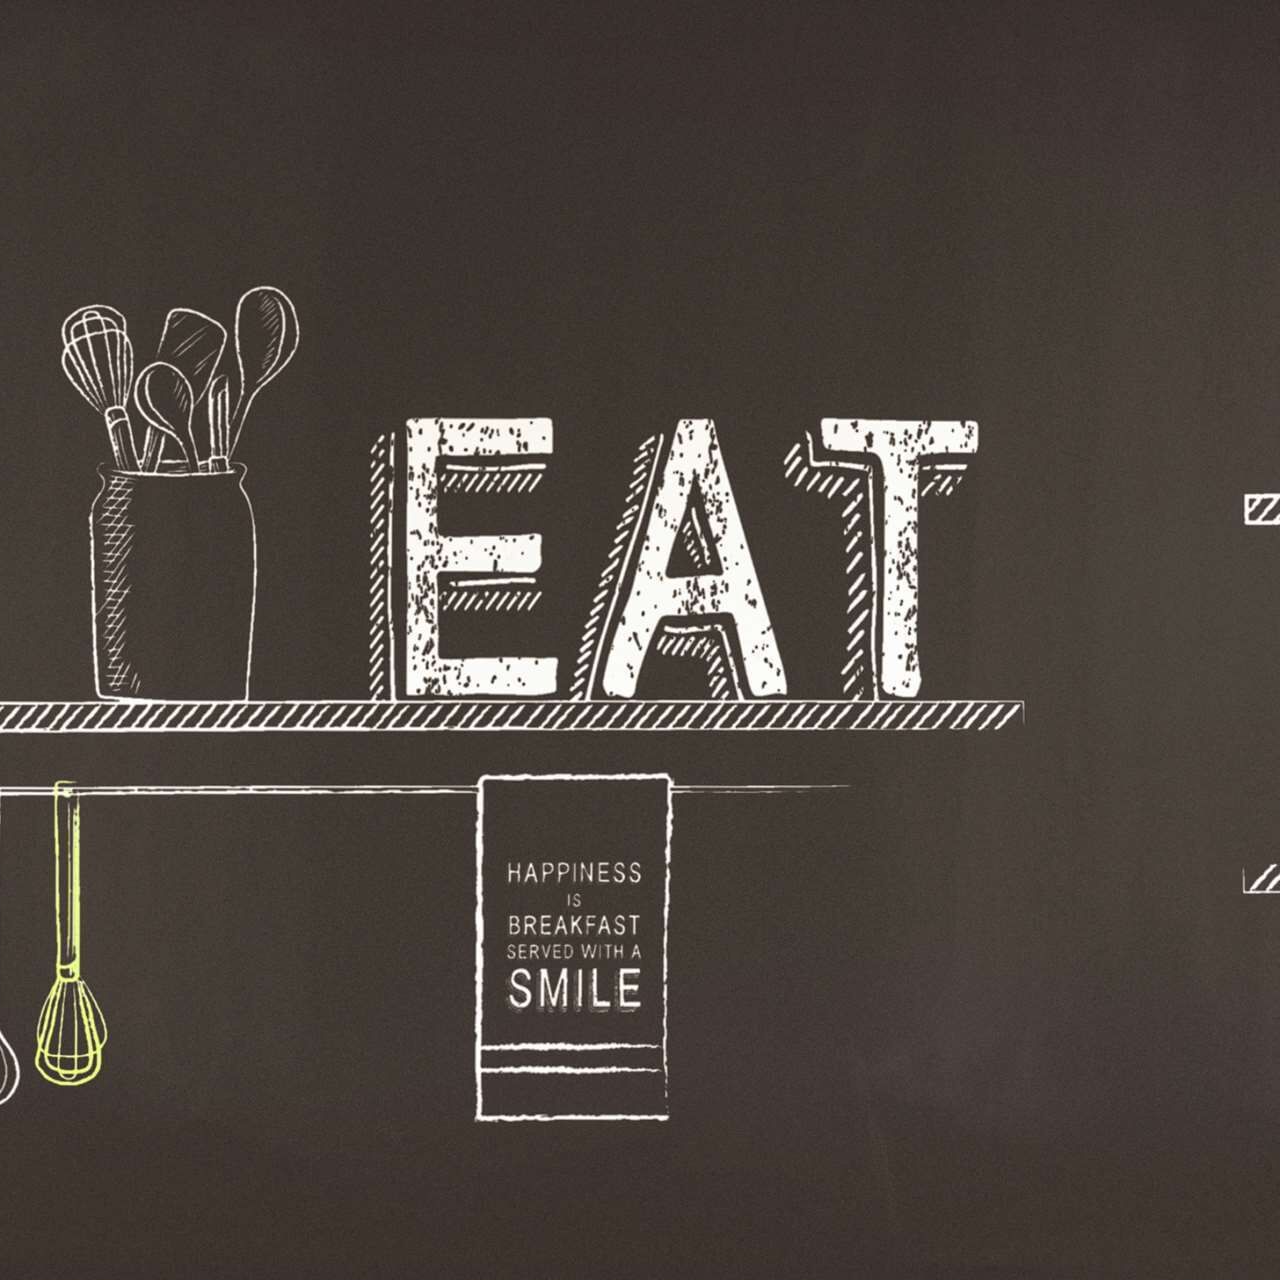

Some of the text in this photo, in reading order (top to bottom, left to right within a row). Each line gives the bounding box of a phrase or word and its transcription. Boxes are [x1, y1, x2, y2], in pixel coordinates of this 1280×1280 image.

[406, 417, 979, 698] EAT
[507, 862, 642, 884] HAPPINESS
[567, 893, 582, 908] IS
[509, 915, 641, 936] BREAKFAST
[506, 944, 642, 960] SERVED WITH A
[509, 968, 642, 1010] SMILE
